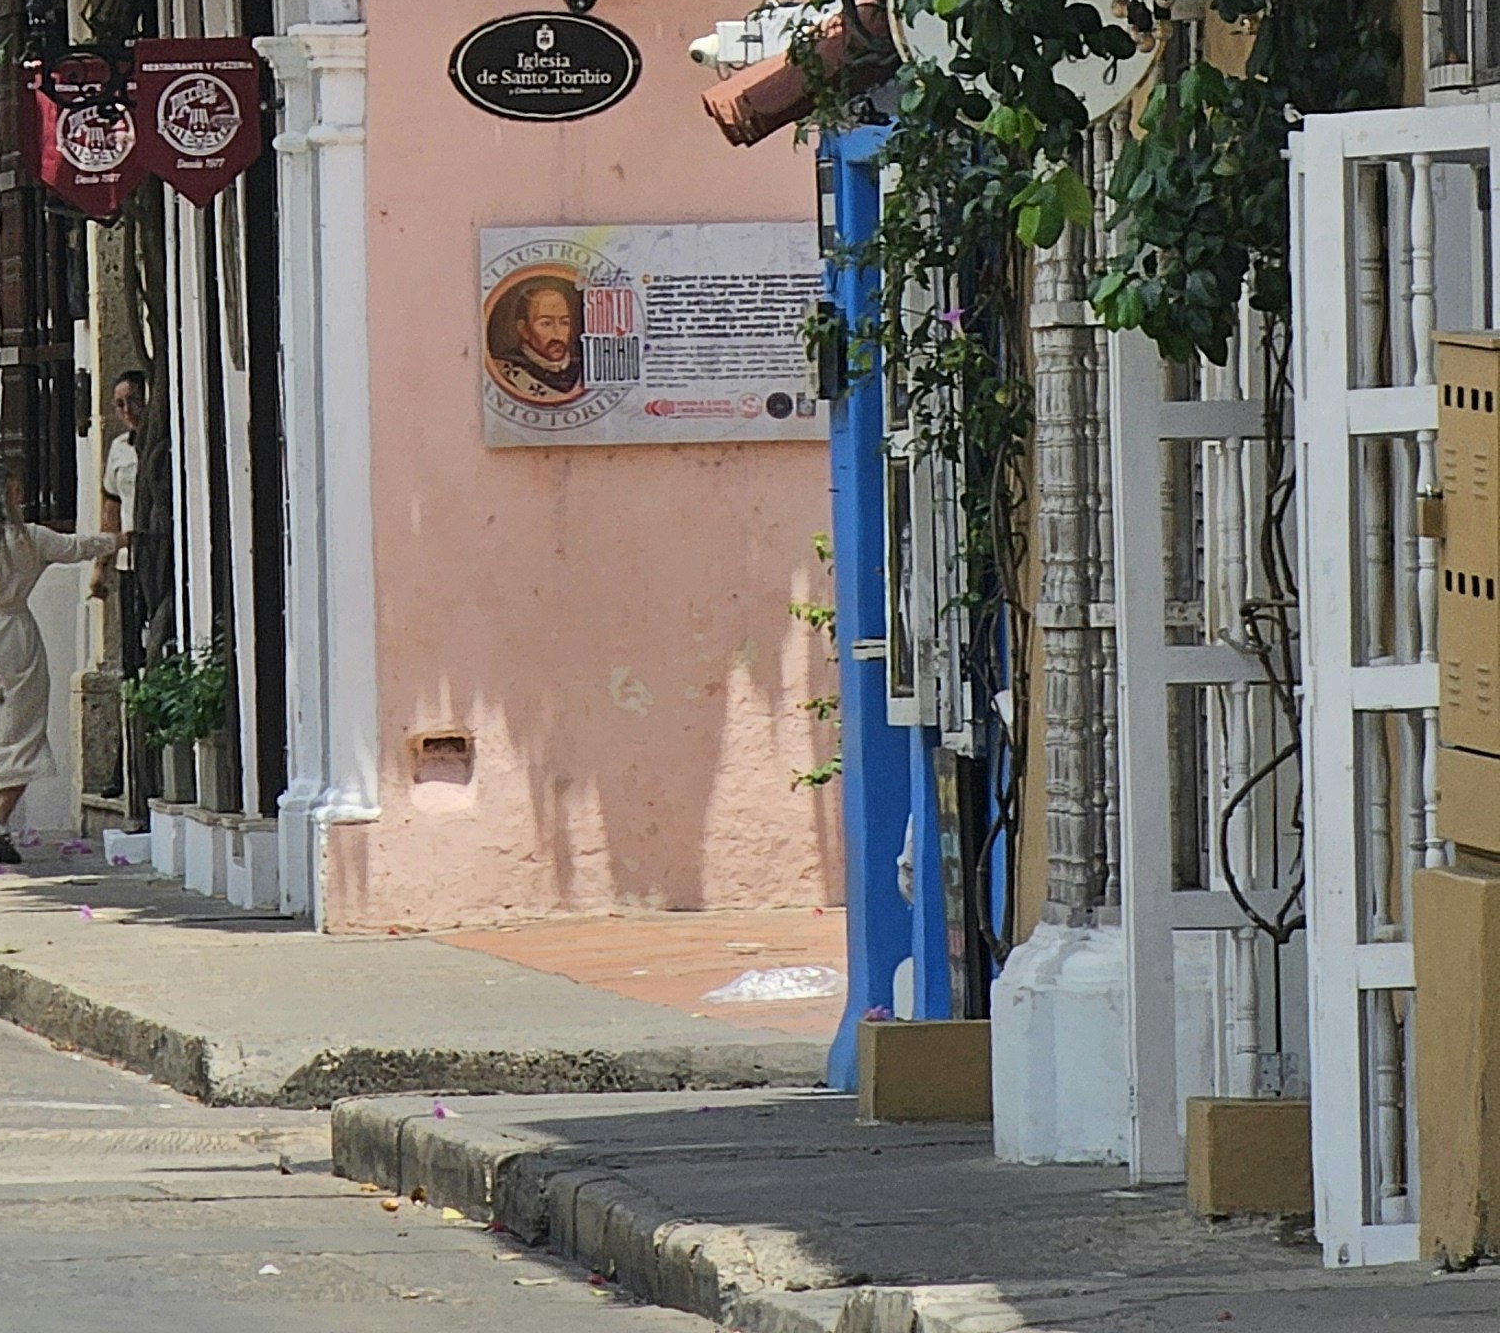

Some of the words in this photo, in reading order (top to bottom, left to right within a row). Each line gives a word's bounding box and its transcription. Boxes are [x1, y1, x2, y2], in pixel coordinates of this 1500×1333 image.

[476, 69, 498, 84] de
[501, 69, 549, 84] Santo
[550, 68, 612, 84] Toribio
[517, 52, 571, 71] Iglesia
[587, 288, 633, 334] SANTO
[584, 335, 640, 382] TORIBIO
[545, 388, 620, 427] TORIB
